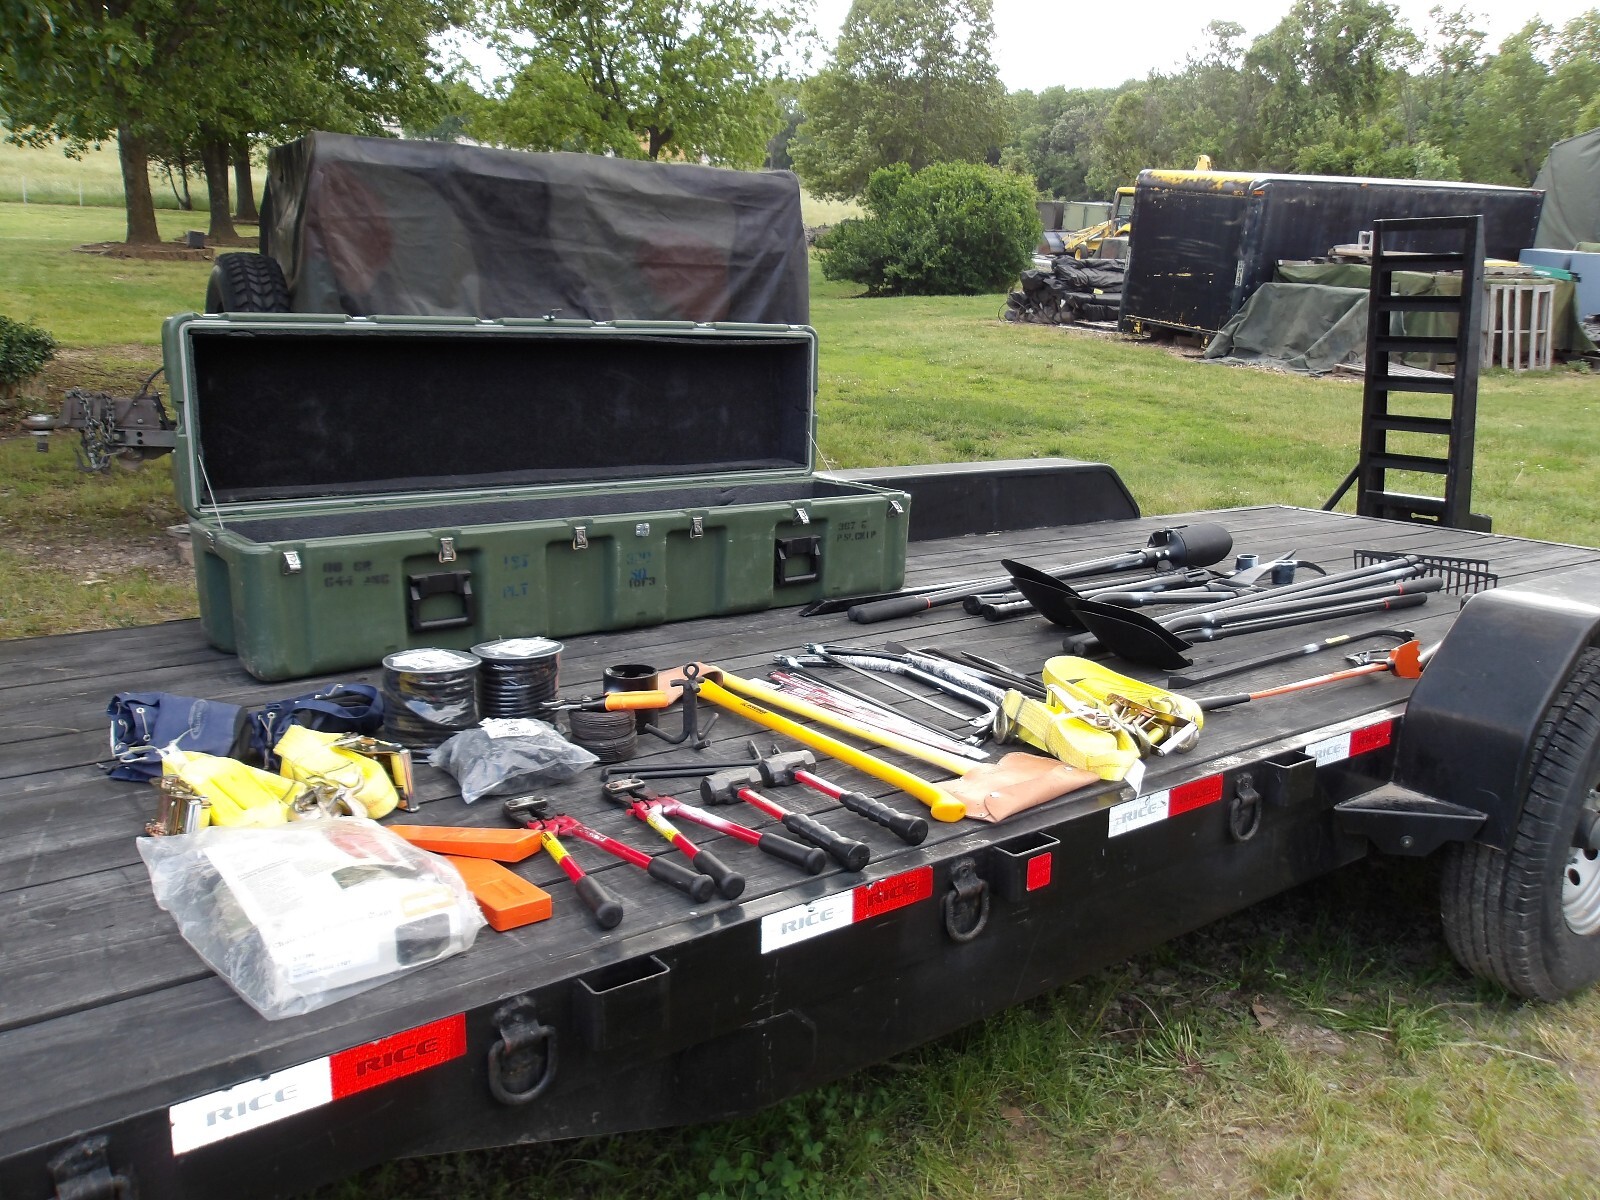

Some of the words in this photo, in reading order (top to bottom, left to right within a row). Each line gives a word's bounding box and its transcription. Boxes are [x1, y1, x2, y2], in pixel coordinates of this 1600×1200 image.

[1315, 743, 1342, 759] RICE
[1118, 803, 1158, 824] RICE
[780, 907, 835, 935] RICE
[866, 880, 917, 908] RICE
[206, 1083, 298, 1127] RICE
[355, 1037, 438, 1077] RICE
